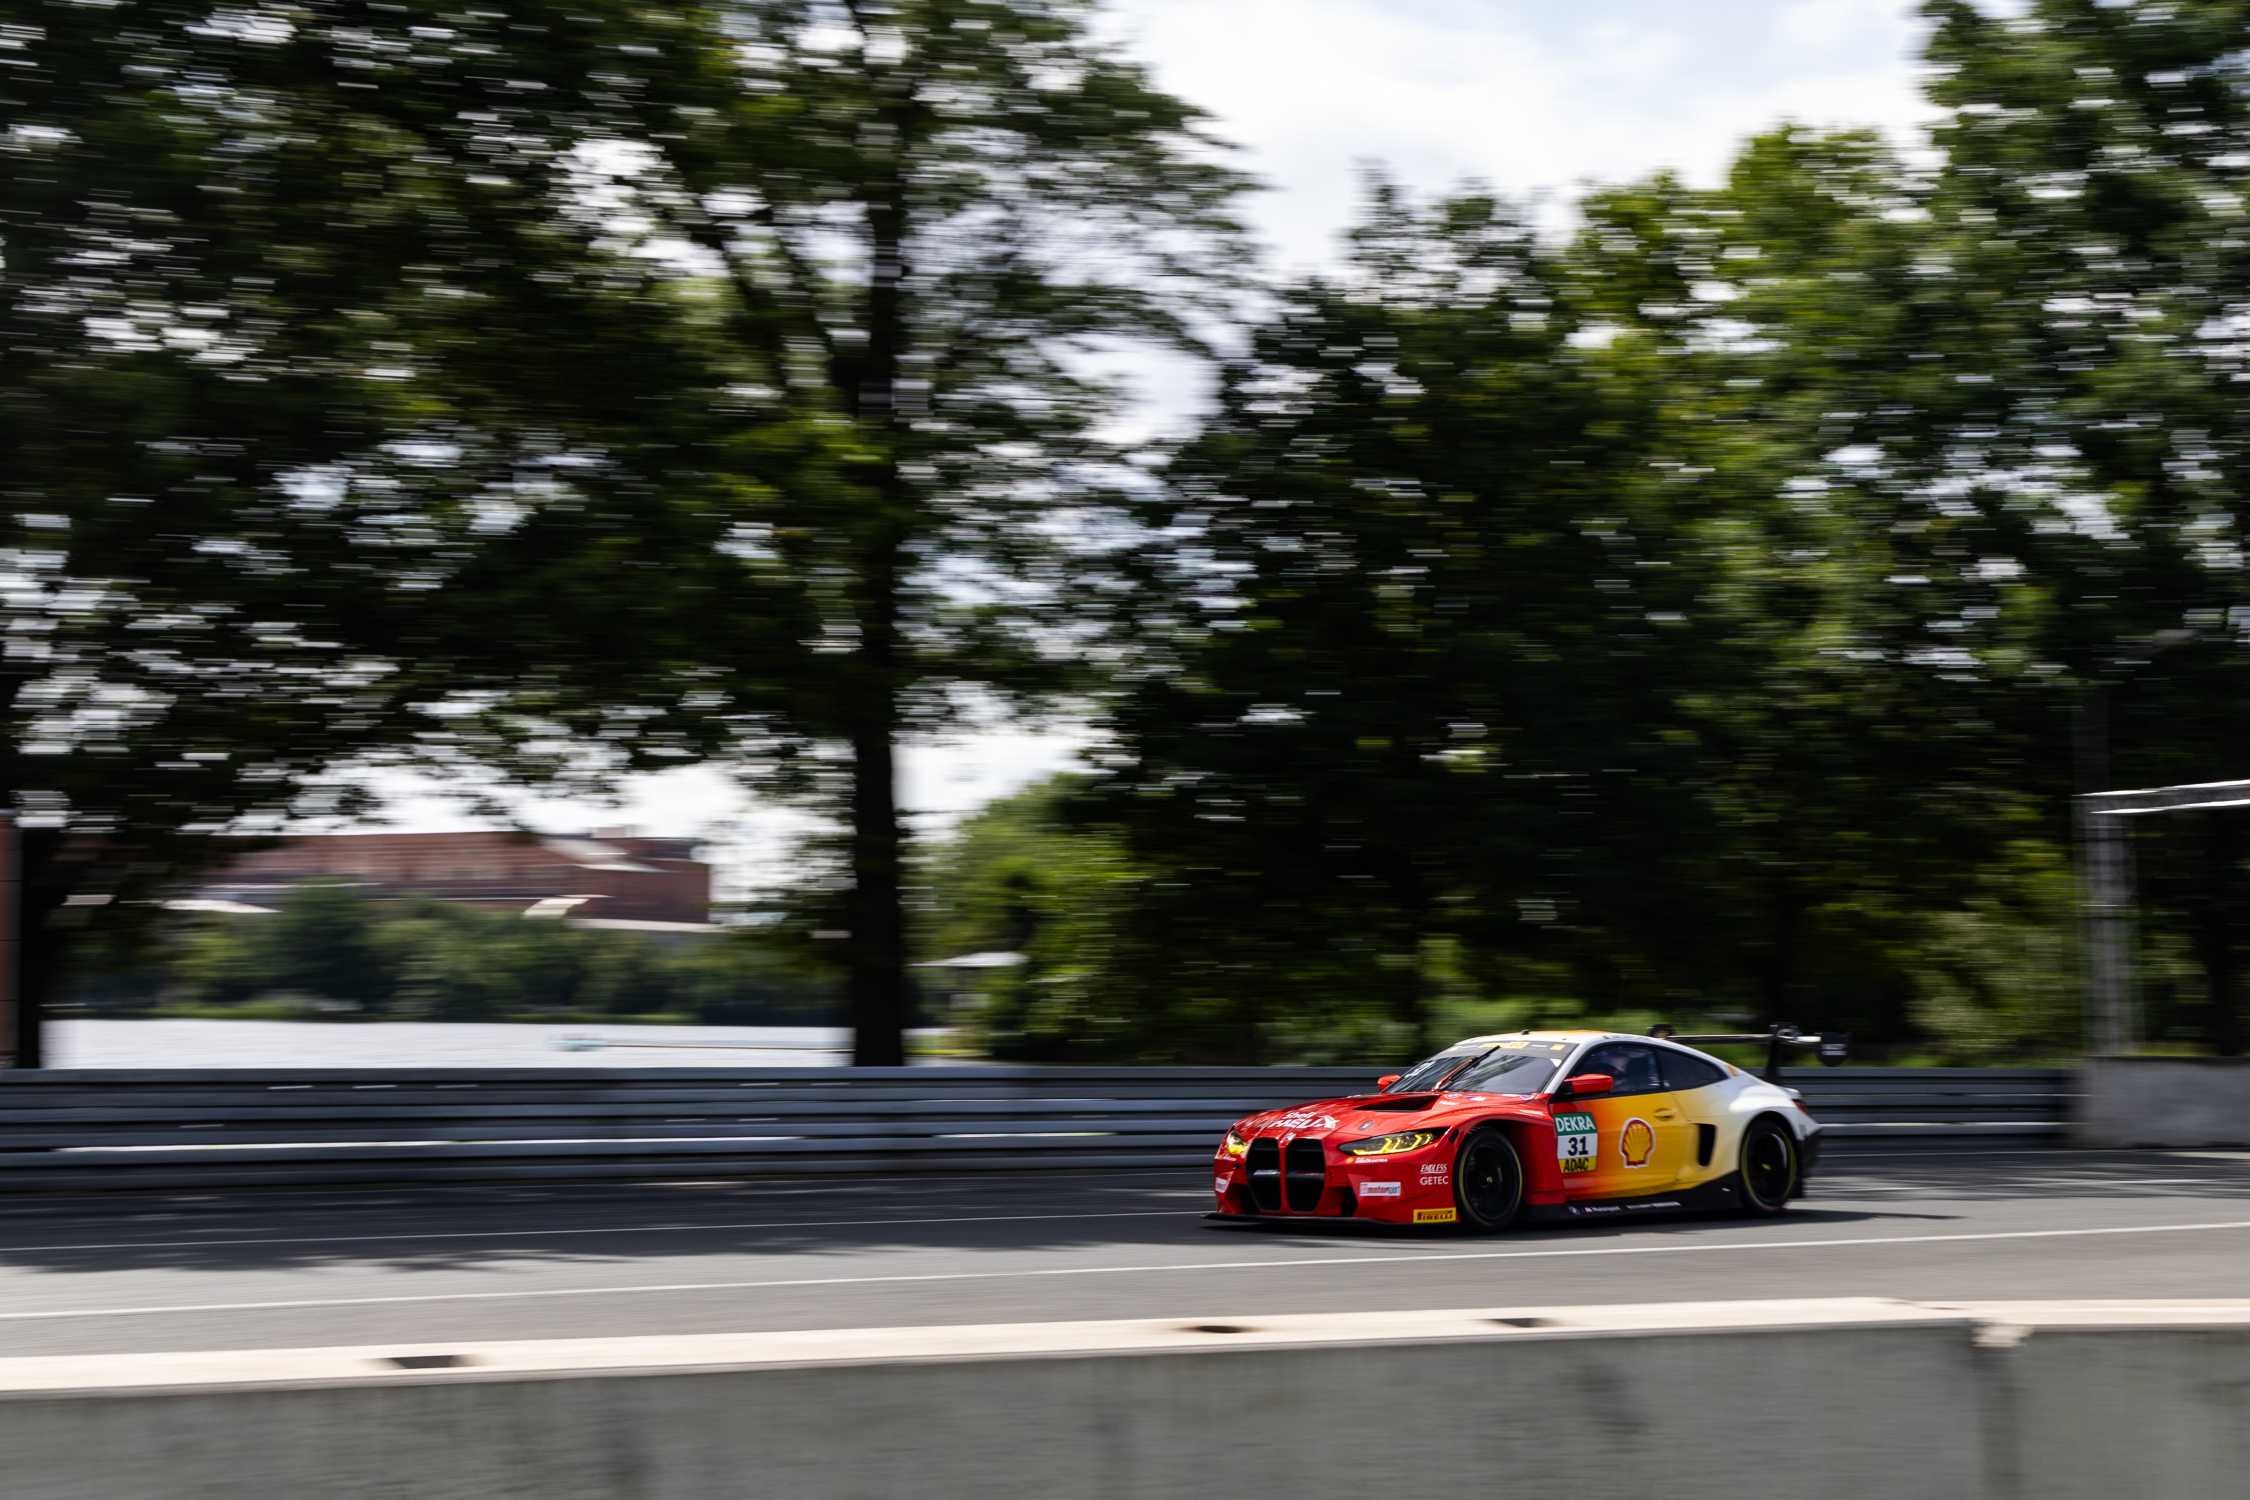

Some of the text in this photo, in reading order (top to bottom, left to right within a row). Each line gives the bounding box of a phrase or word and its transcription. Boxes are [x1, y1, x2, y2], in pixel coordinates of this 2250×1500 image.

[1555, 1115, 1597, 1132] DEKRA
[1568, 1136, 1588, 1156] 31
[1563, 1157, 1589, 1172] ADAC
[1420, 1176, 1449, 1186] GETEC
[1417, 1210, 1453, 1221] PIRELLI
